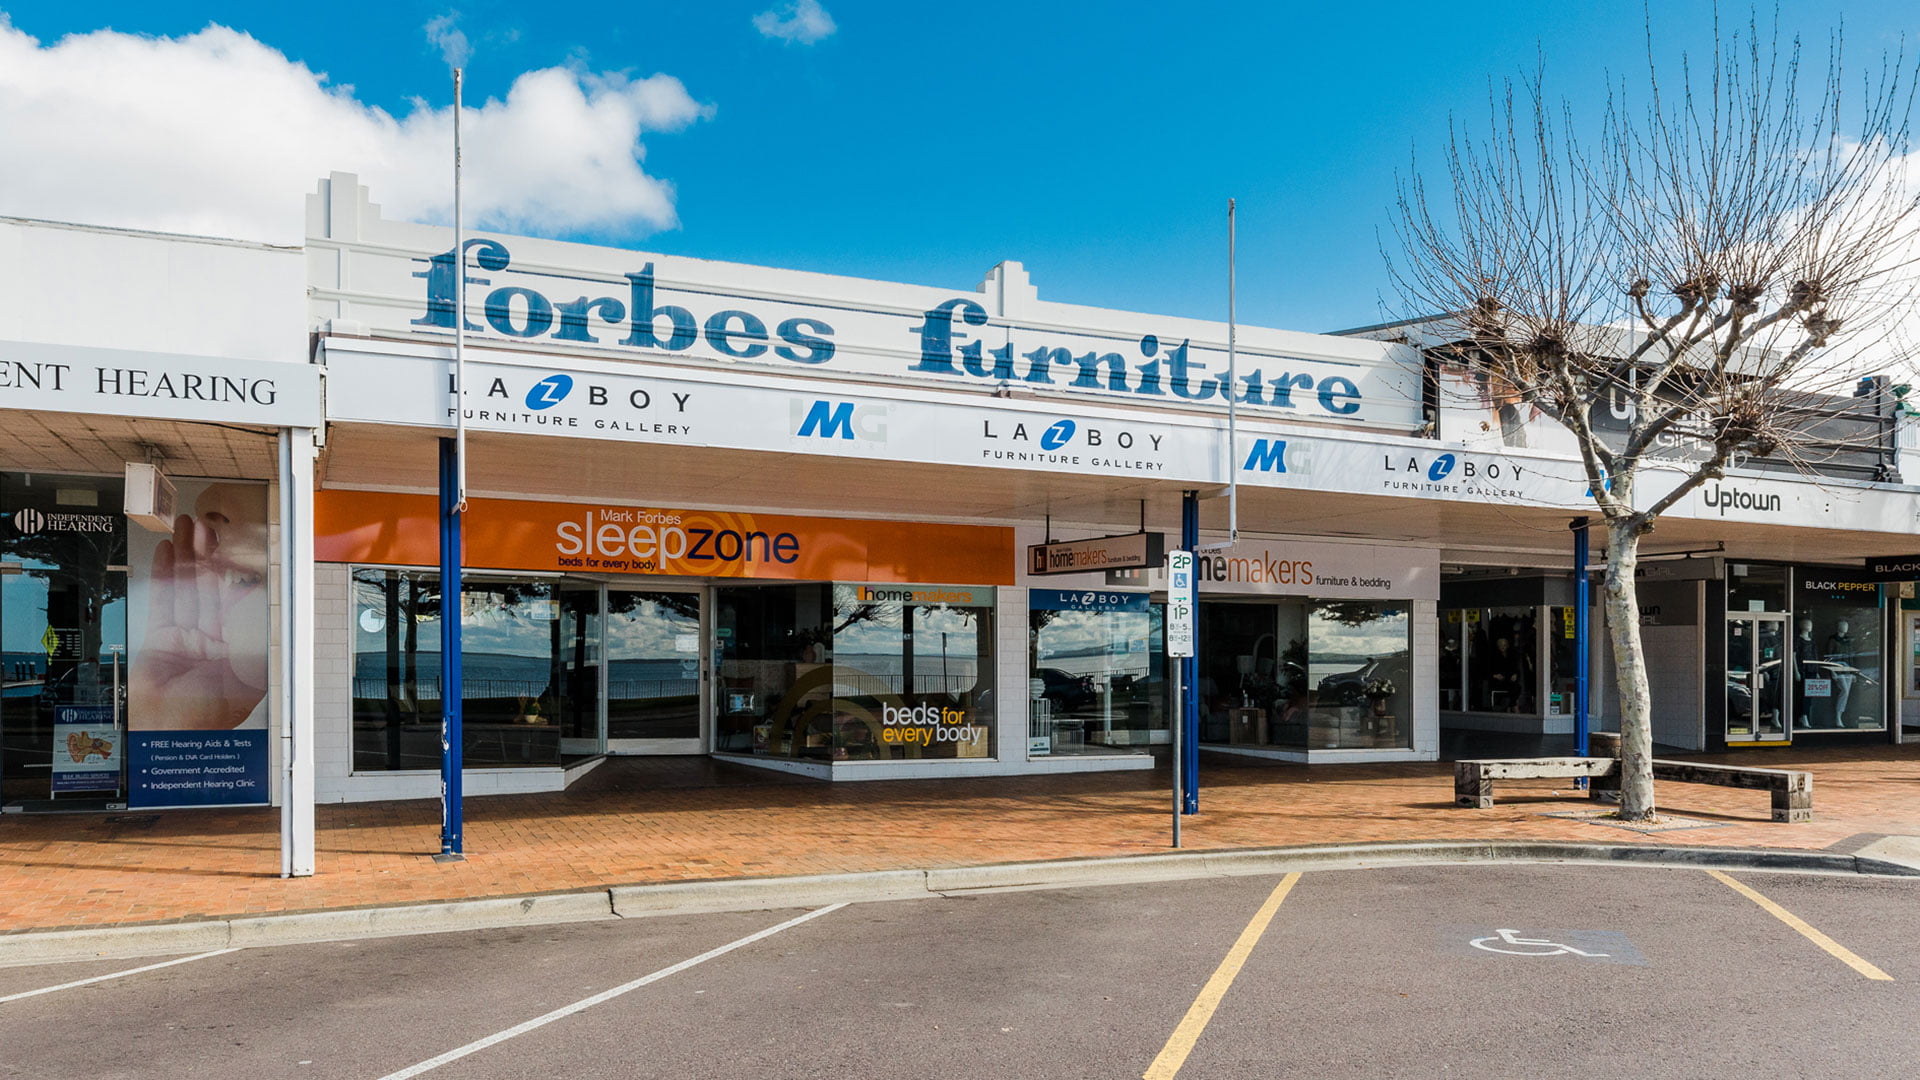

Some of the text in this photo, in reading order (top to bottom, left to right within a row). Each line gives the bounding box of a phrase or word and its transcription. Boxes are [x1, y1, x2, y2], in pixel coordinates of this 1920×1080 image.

[411, 238, 1364, 415] forbes furniture
[95, 366, 278, 405] HEARING
[448, 408, 691, 435] FURNITURE GALLERY
[983, 450, 1164, 471] FURNITURE GALLERY
[1384, 481, 1523, 499] FURNITURE GALLERY
[1704, 483, 1780, 516] Uptown
[47, 513, 114, 522] INDEPENDENT
[600, 509, 681, 525] Mark Forbes
[47, 520, 114, 533] HEARING
[556, 511, 800, 570] sleepzone
[558, 556, 656, 571] beds for every body
[1049, 547, 1107, 569] homemakers
[1173, 556, 1191, 569] 2P
[1316, 576, 1348, 587] furniture
[1351, 577, 1357, 587] &
[1359, 578, 1391, 589] bedding
[1805, 581, 1875, 591] BLACK PEPPER
[864, 586, 972, 603] homemakers
[1174, 607, 1188, 620] 1P
[882, 701, 965, 725] beds for
[882, 722, 983, 747] every body
[150, 739, 252, 750] FREE Hearing Aids & Tests
[185, 753, 198, 761] DVA
[199, 753, 214, 761] Card
[150, 765, 245, 776] Government Accredited
[150, 778, 256, 791] Independent Hearing Clinic
